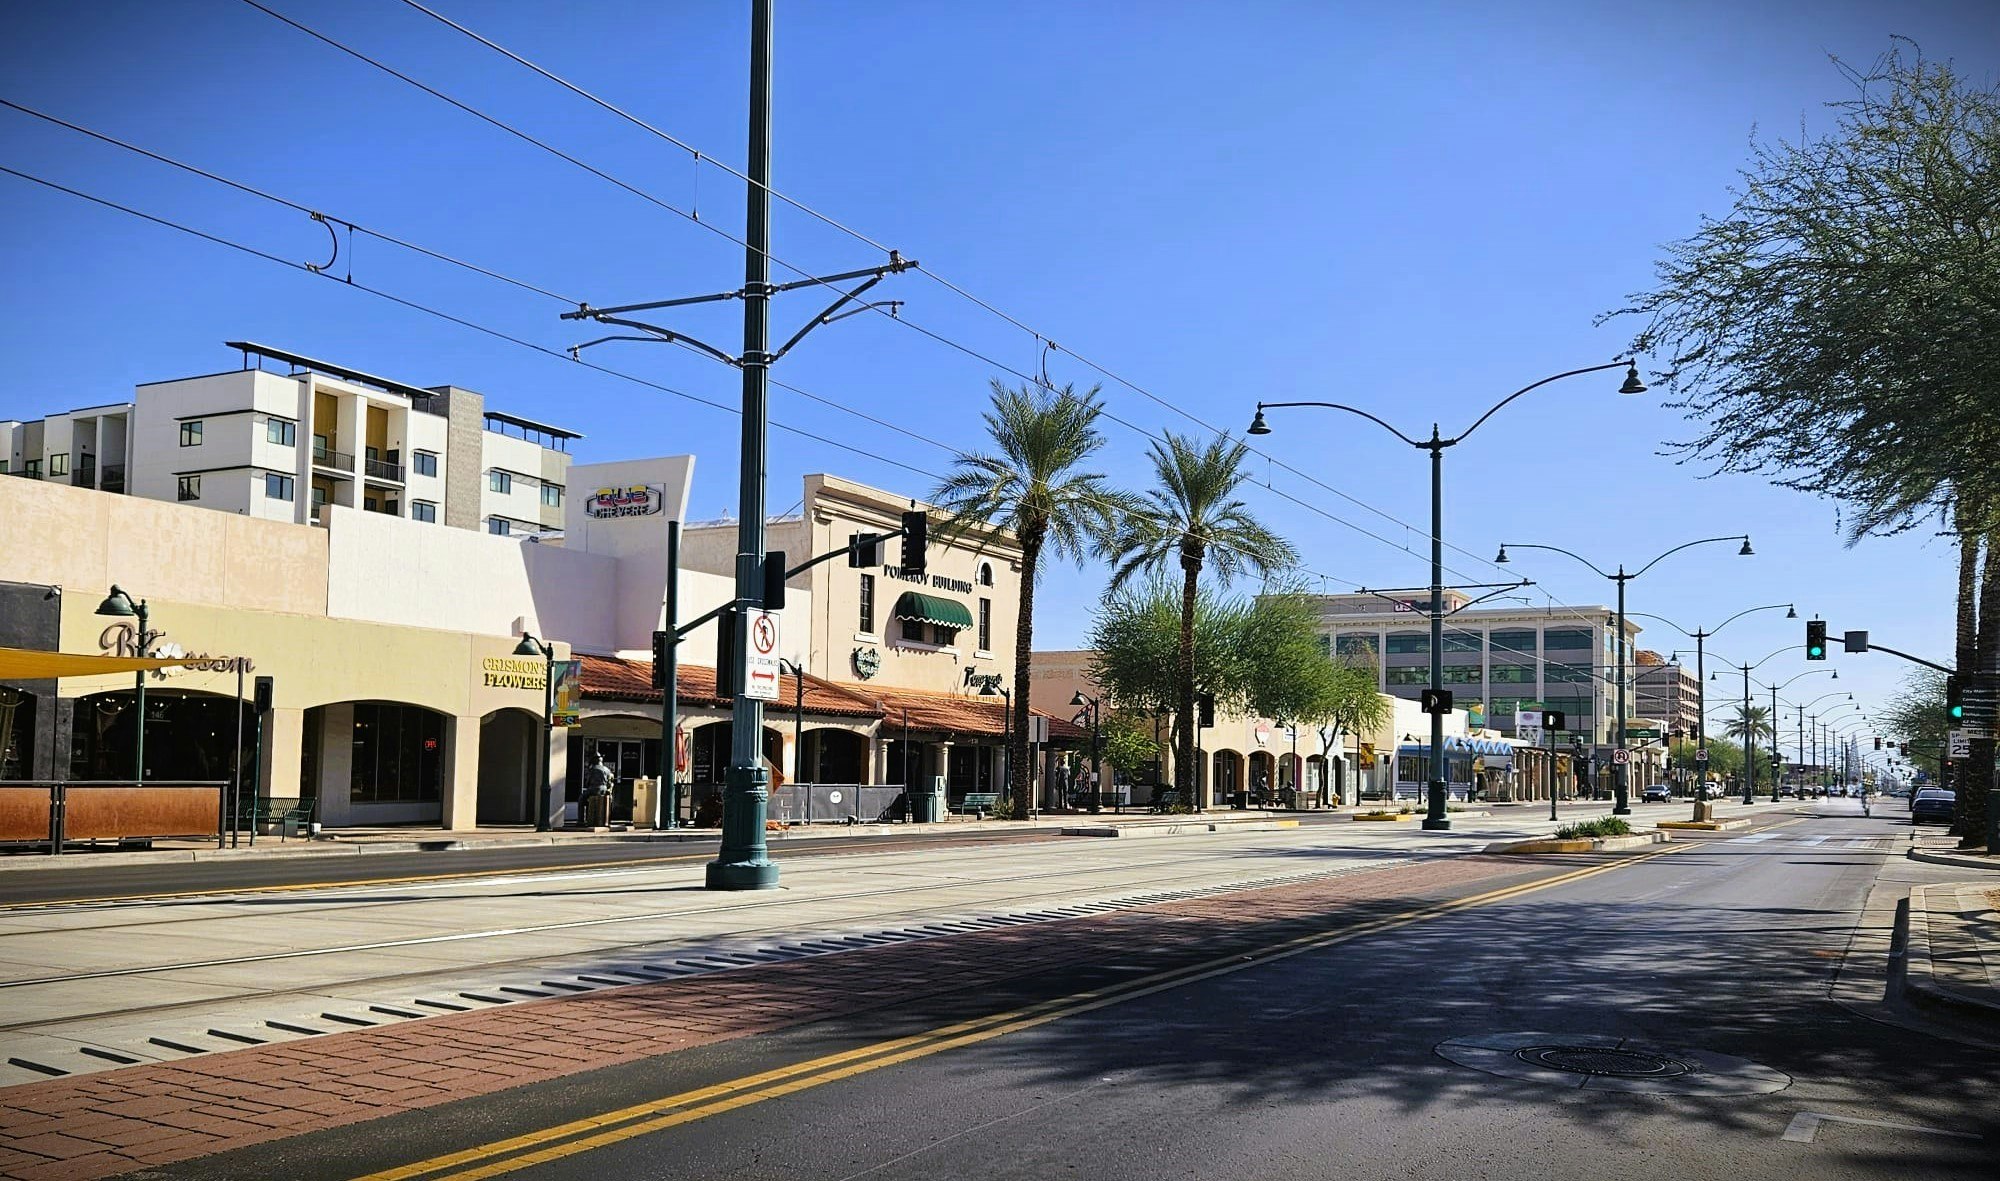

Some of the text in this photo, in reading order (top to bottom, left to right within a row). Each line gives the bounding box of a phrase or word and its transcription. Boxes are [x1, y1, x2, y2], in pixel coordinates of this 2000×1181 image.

[596, 485, 648, 506] QUE
[594, 505, 649, 519] CHEVERE
[932, 575, 973, 594] BUILDING
[98, 621, 256, 674] Blssom
[485, 673, 547, 690] FLOWERS
[1952, 745, 1970, 754] 25
